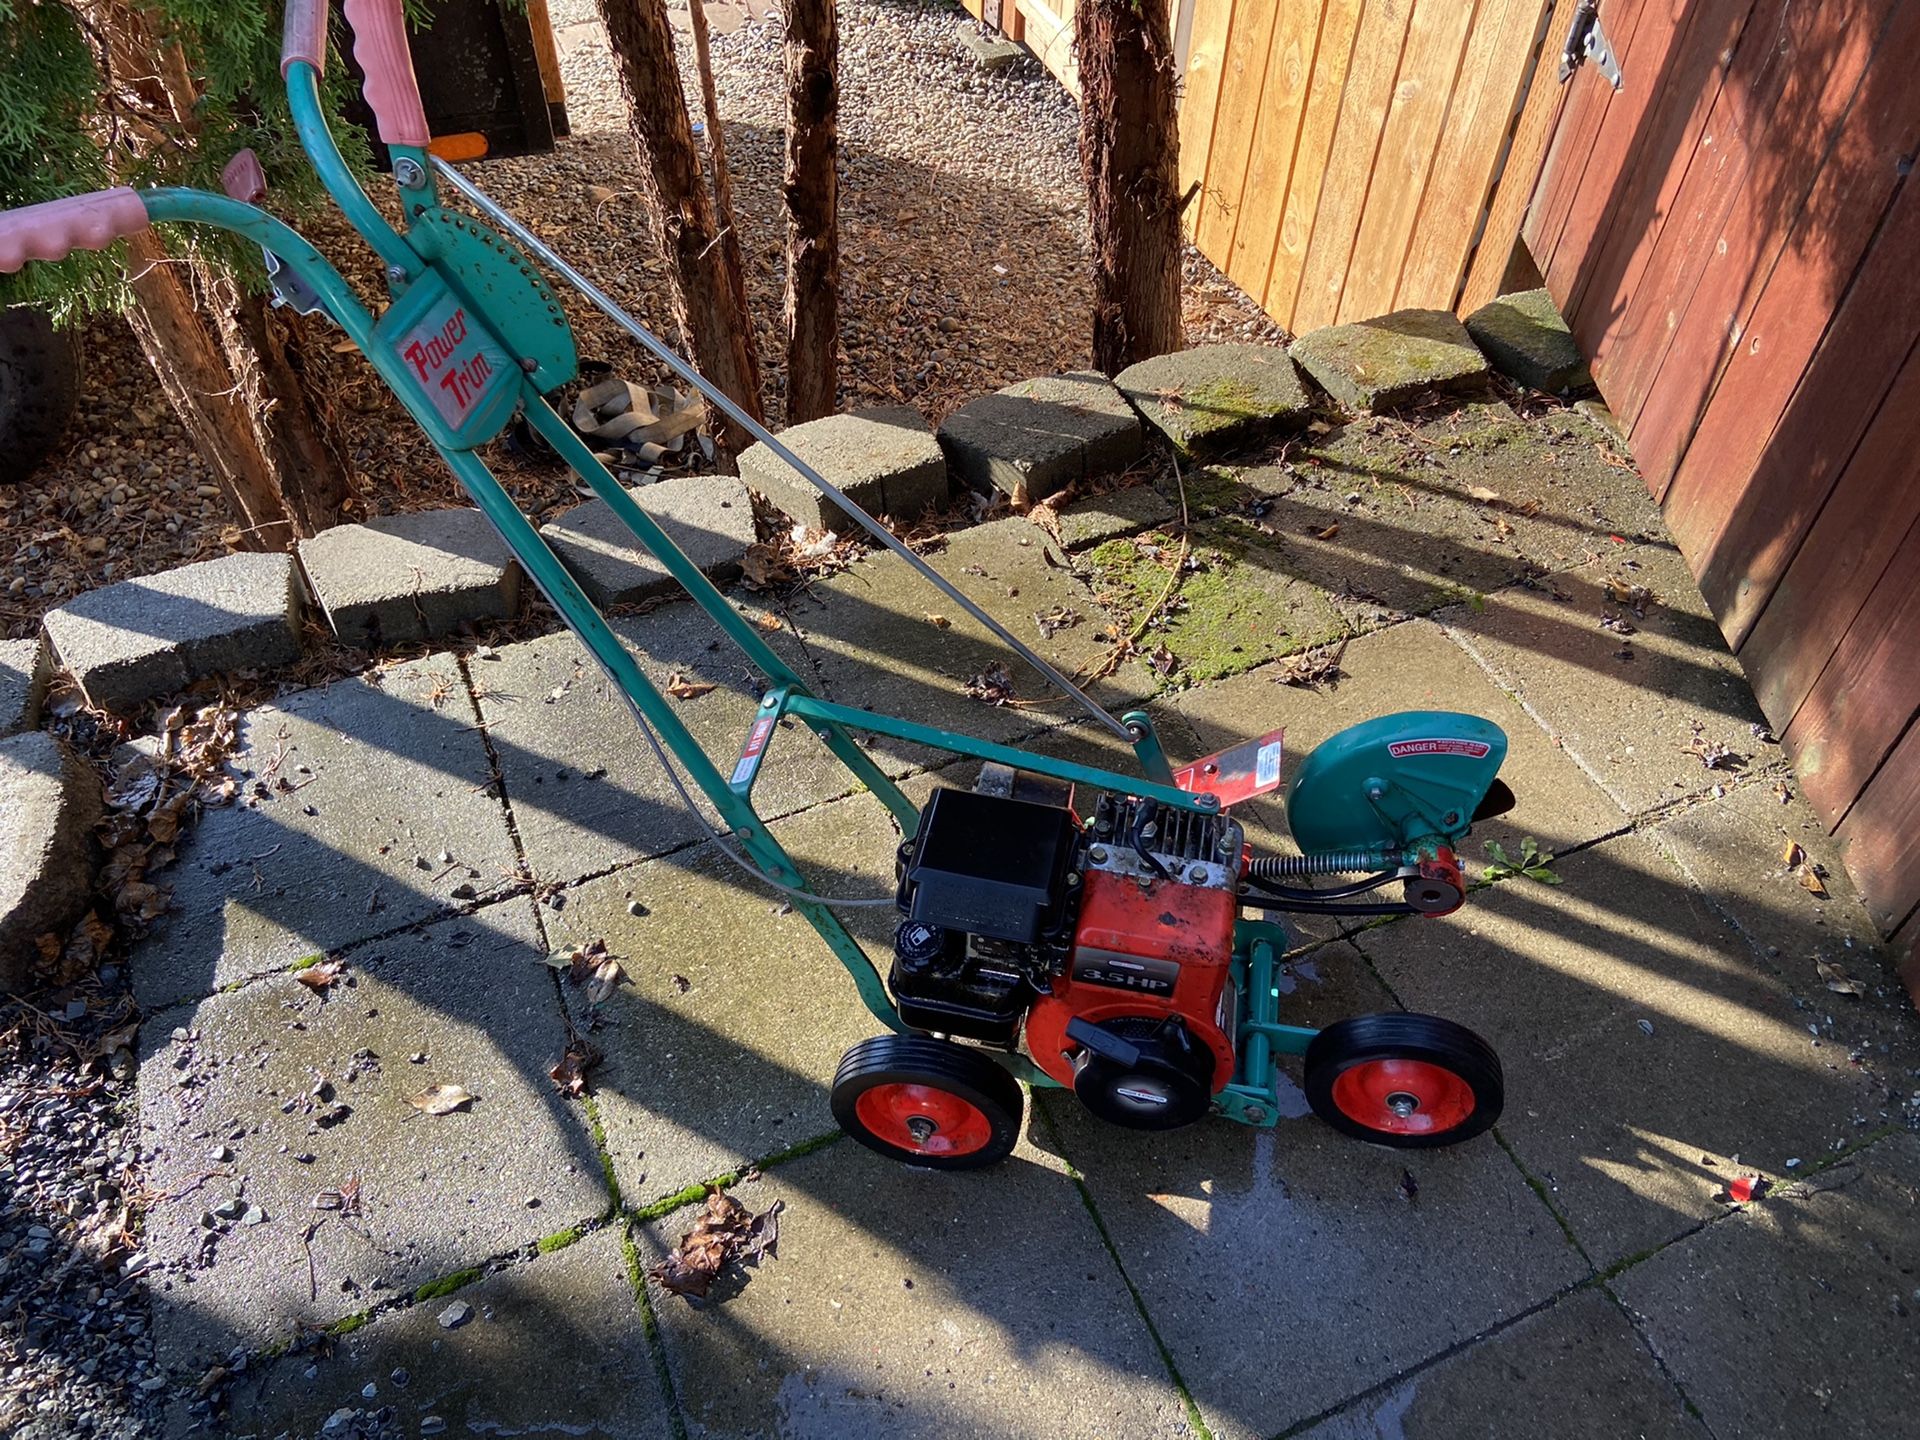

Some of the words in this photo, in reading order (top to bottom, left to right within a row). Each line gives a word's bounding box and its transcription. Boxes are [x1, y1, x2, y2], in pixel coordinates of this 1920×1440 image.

[404, 307, 467, 384] Power
[440, 352, 493, 409] Trim
[1392, 742, 1437, 755] DANGER
